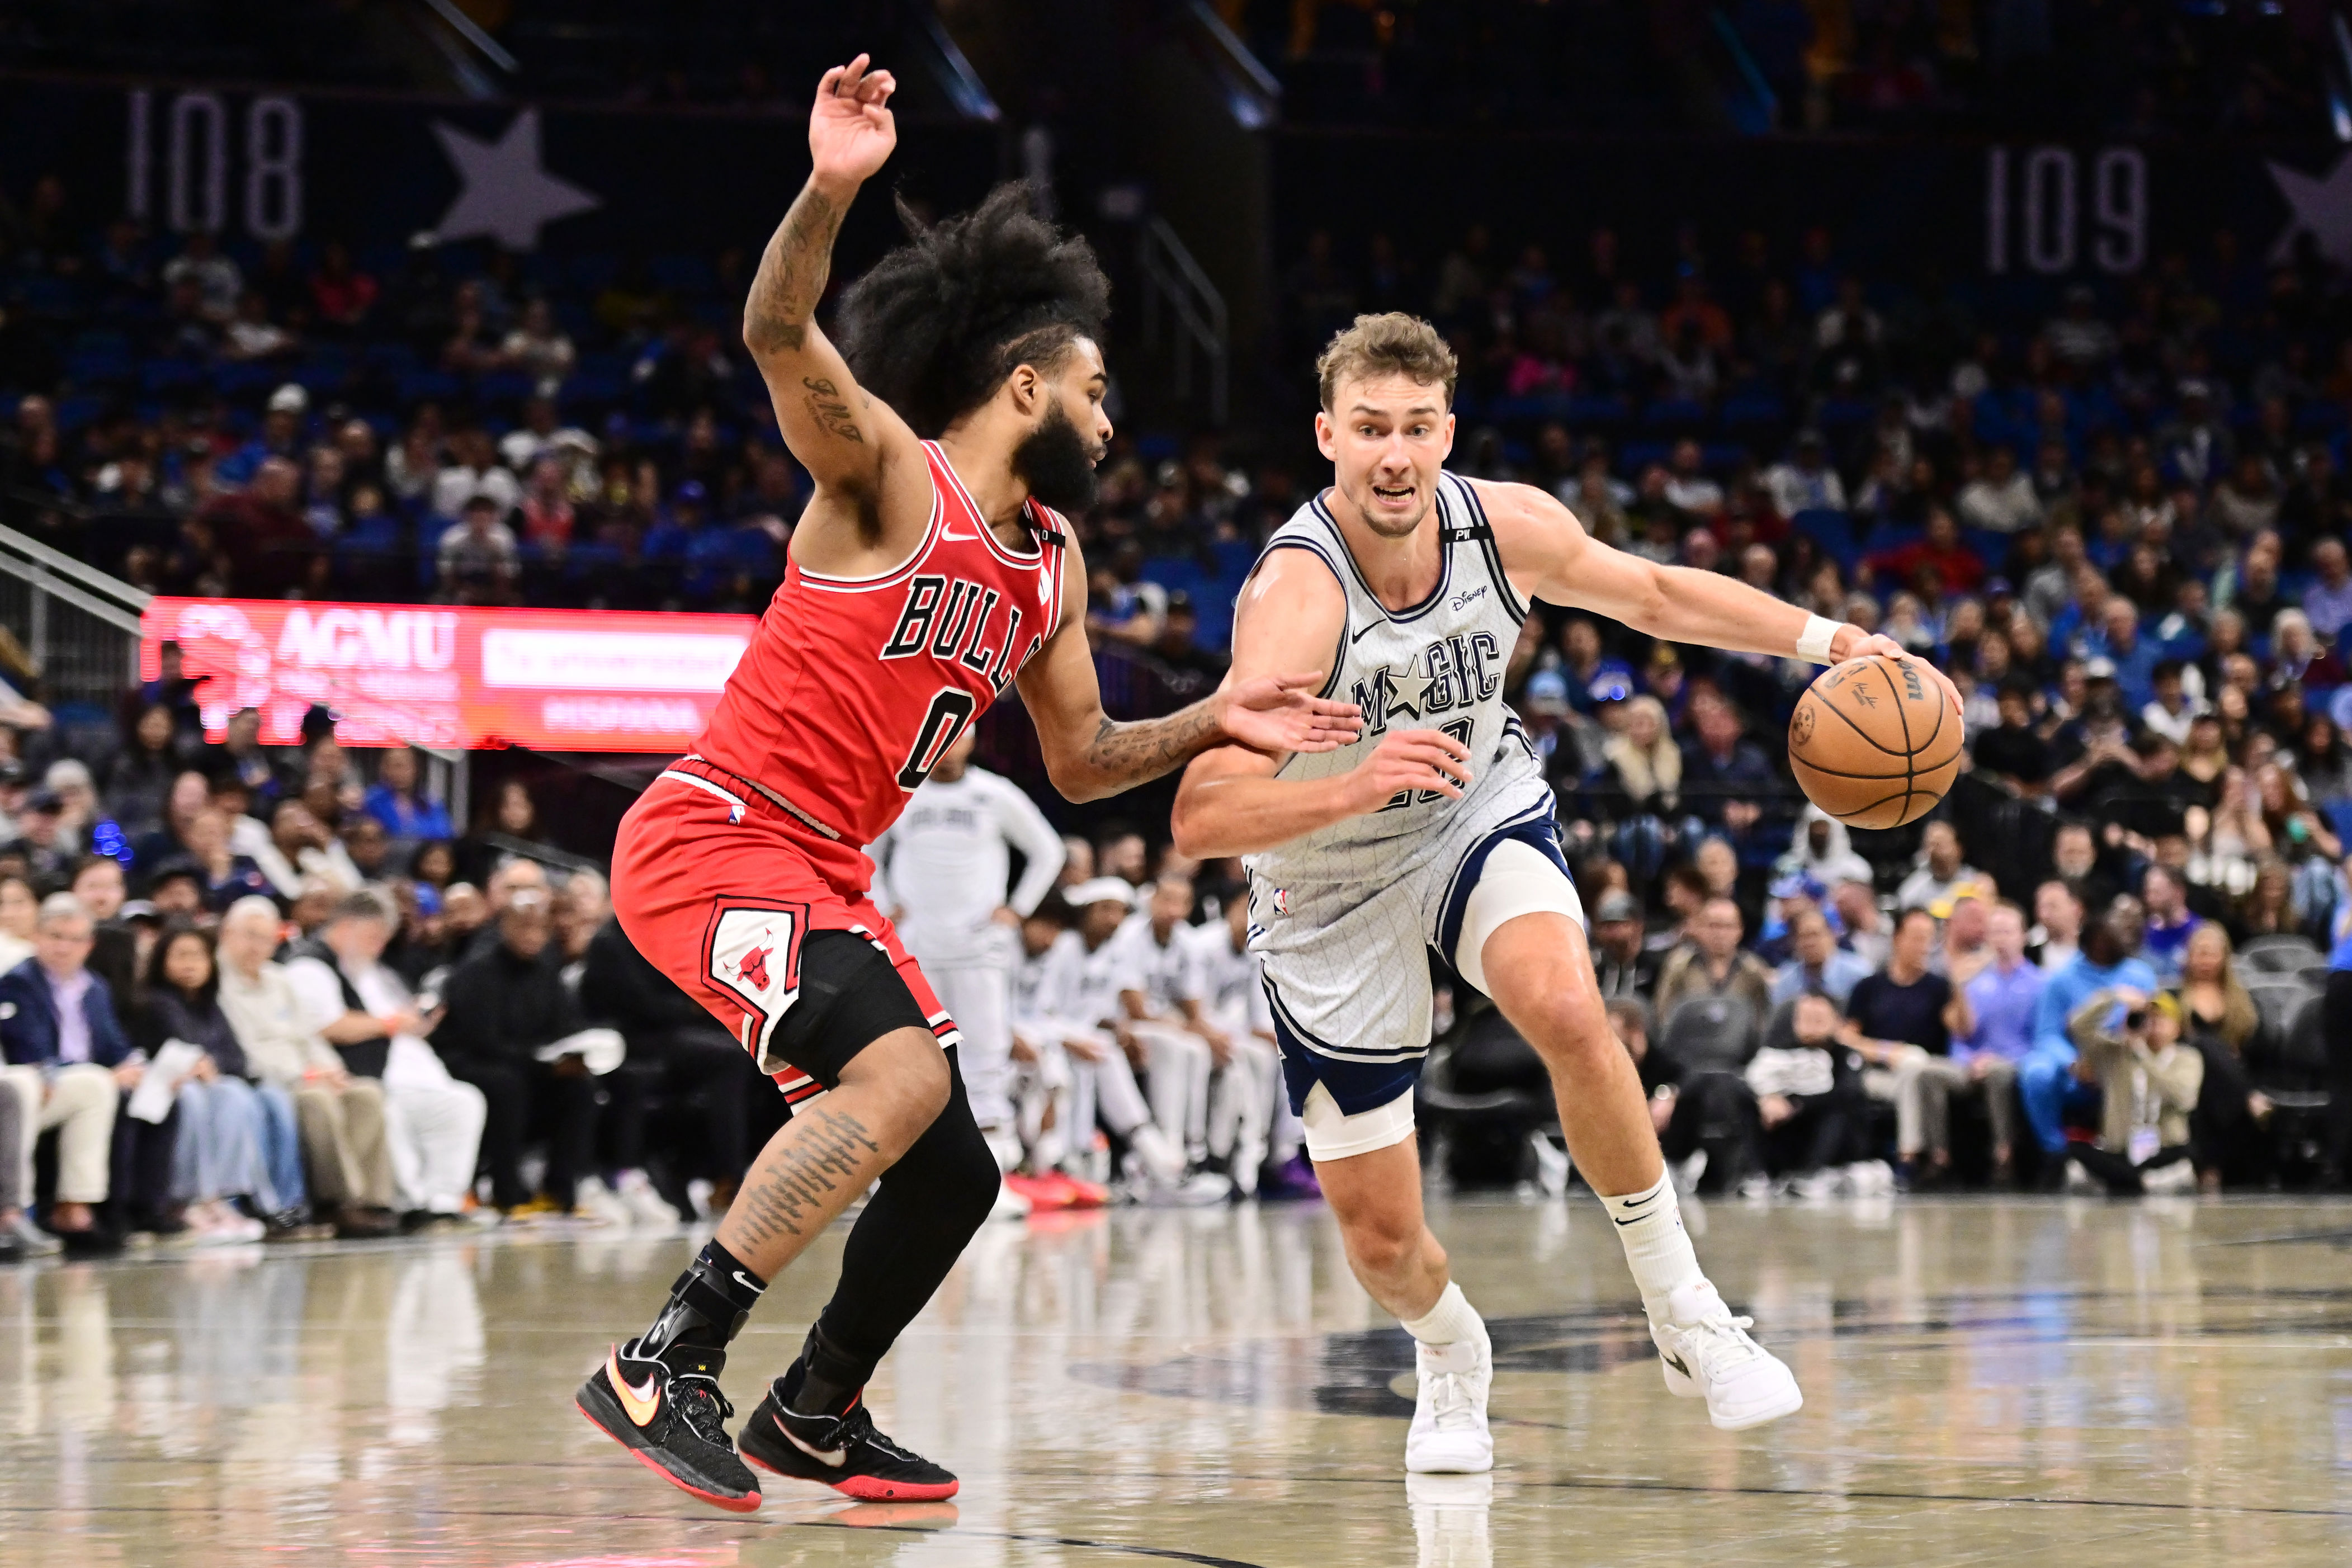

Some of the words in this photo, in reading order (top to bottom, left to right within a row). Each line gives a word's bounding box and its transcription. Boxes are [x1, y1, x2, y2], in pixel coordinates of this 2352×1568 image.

[126, 88, 303, 242] 108
[1986, 145, 2147, 275] 109
[1455, 528, 1470, 541] PW
[895, 686, 976, 793] 0
